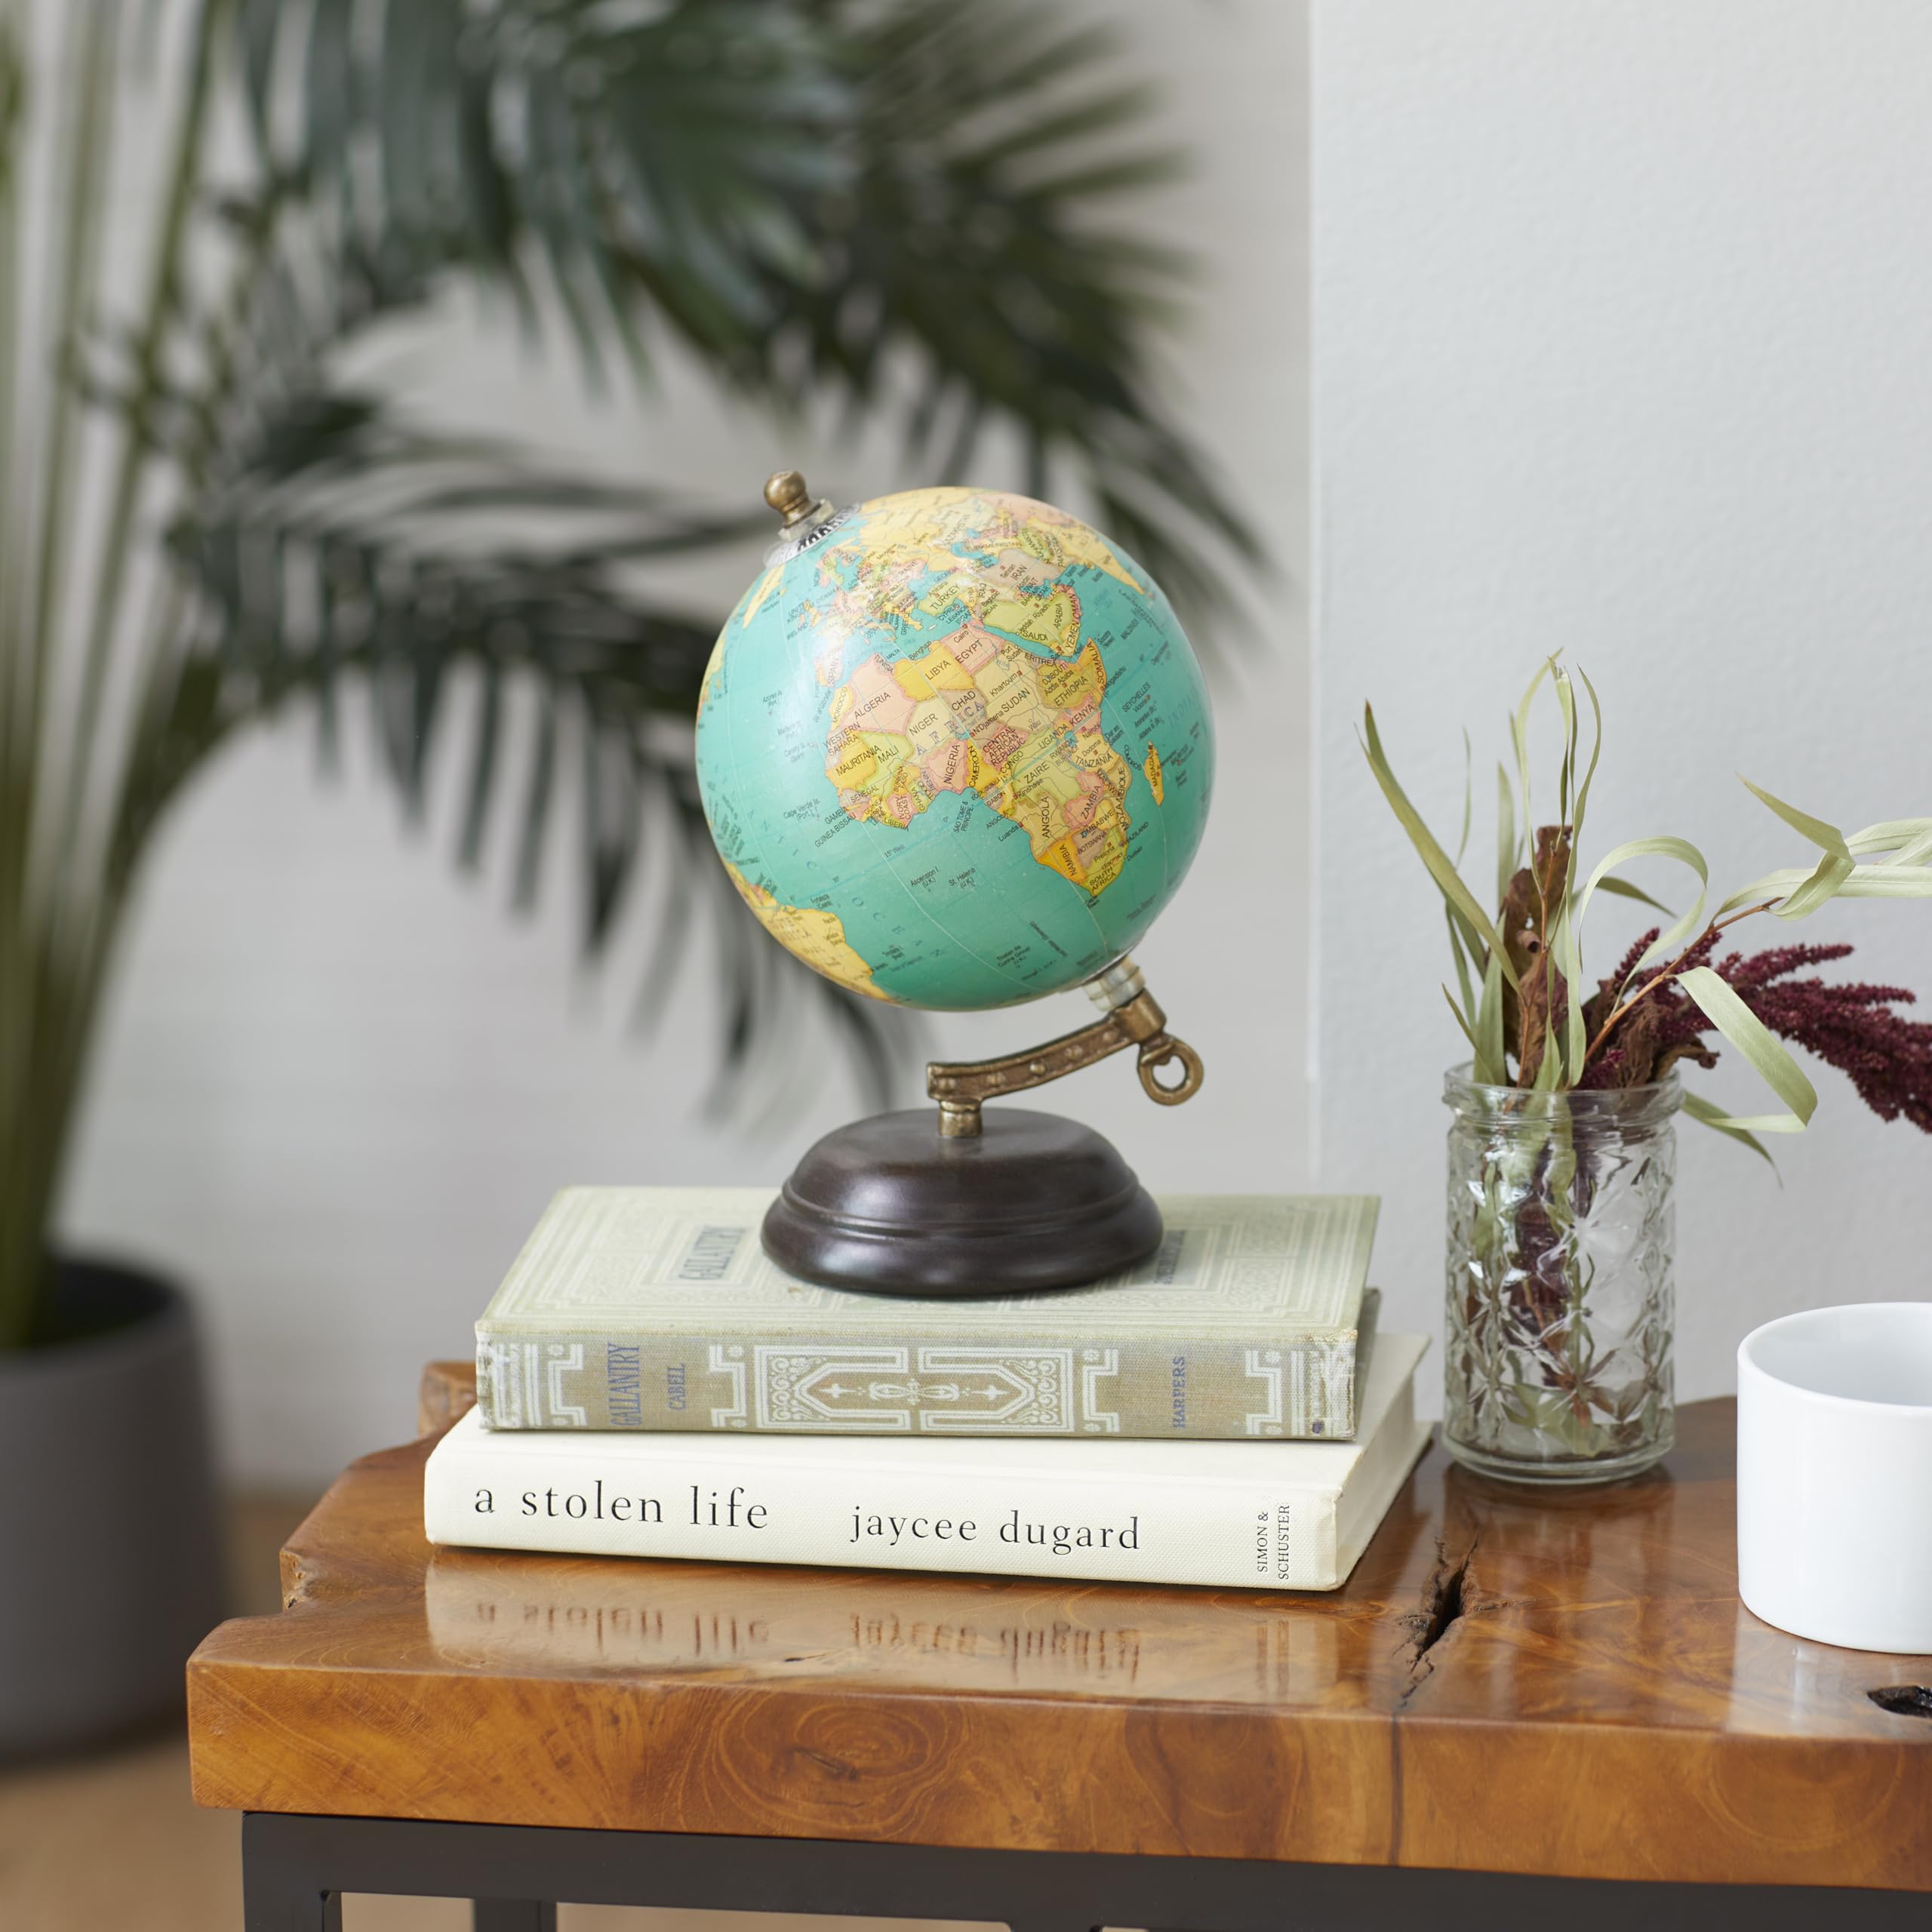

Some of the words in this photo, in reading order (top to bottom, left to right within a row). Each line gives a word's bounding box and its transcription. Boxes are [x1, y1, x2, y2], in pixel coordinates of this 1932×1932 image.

[1011, 565, 1027, 580] IRAN
[930, 584, 960, 610] TURKEY
[978, 583, 986, 598] IRAQ
[1022, 629, 1048, 641] SAUDI
[1053, 603, 1063, 629] ARABIA
[1032, 603, 1051, 620] Riyadh
[953, 629, 970, 644] Cairo
[1065, 622, 1079, 650] YEMEN
[908, 641, 932, 660] Benghazi
[955, 638, 983, 664] EGYPT
[1001, 645, 1013, 656] Port
[1006, 648, 1023, 662] Sudan
[1024, 653, 1057, 667] ERITREA
[827, 657, 840, 685] SPAIN
[874, 654, 894, 674] TUNISIA
[924, 660, 951, 681] LIBYA
[1087, 641, 1105, 685] SOMALIA
[989, 672, 1018, 697] Khartoum
[1044, 681, 1060, 696] Addis
[1053, 675, 1088, 706] ETHIOPIA
[832, 687, 848, 724] MOROCCO
[854, 691, 891, 720] ALGERIA
[951, 690, 977, 711] CHAD
[1001, 688, 1031, 712] SUDAN
[909, 712, 939, 737] NIGER
[1069, 704, 1095, 727] KENYA
[823, 721, 861, 749] WESTERN
[983, 726, 1016, 753] CENTRAL
[1038, 723, 1069, 749] UGANDA
[1081, 721, 1102, 740] Nairobi
[827, 734, 859, 756] SAHARA
[878, 745, 900, 764] MALI
[989, 732, 1020, 760] AFRICAN
[990, 737, 1026, 768] REPUBLIC
[1081, 739, 1102, 757] Dodoma
[835, 744, 881, 777] MAURITANIA
[943, 743, 961, 785] NIGERIA
[968, 745, 980, 789] CAMEROON
[1000, 750, 1024, 774] CONGO
[1074, 752, 1115, 768] TANZANIA
[921, 770, 936, 792] BENIN
[1023, 761, 1051, 785] ZAIRE
[850, 785, 880, 804] SENEGAL
[911, 786, 926, 812] GHANA
[918, 781, 934, 801] TOGO
[986, 790, 1006, 808] GABON
[1080, 785, 1102, 820] ZAMBIA
[1115, 765, 1131, 832] MOZAMBIQUE
[823, 805, 849, 825] GAMBIA
[896, 796, 905, 820] IVORY
[900, 795, 912, 820] COAST
[1041, 795, 1051, 838] ANGOLA
[814, 829, 835, 848] GUINEA
[835, 812, 857, 832] BISSAU
[883, 817, 910, 832] LIBERIA
[998, 824, 1019, 842] Luanda
[1077, 831, 1108, 855] BOTSWANA
[1094, 845, 1115, 863] Pretoria
[1059, 844, 1078, 876] NAMIBIA
[1089, 866, 1113, 886] SOUTH
[1091, 872, 1117, 893] AFRICA
[608, 1342, 644, 1427] GALLANTRY
[666, 1363, 687, 1411] CABELL
[1171, 1355, 1186, 1429] HARPERS
[474, 1489, 495, 1514] a
[521, 1480, 664, 1524] stolen
[690, 1485, 768, 1529] life
[1257, 1511, 1269, 1521] &
[850, 1505, 978, 1546] jaycee
[999, 1509, 1140, 1556] dugard
[1278, 1505, 1290, 1580] SCHUSTER
[1257, 1526, 1269, 1573] SIMON
